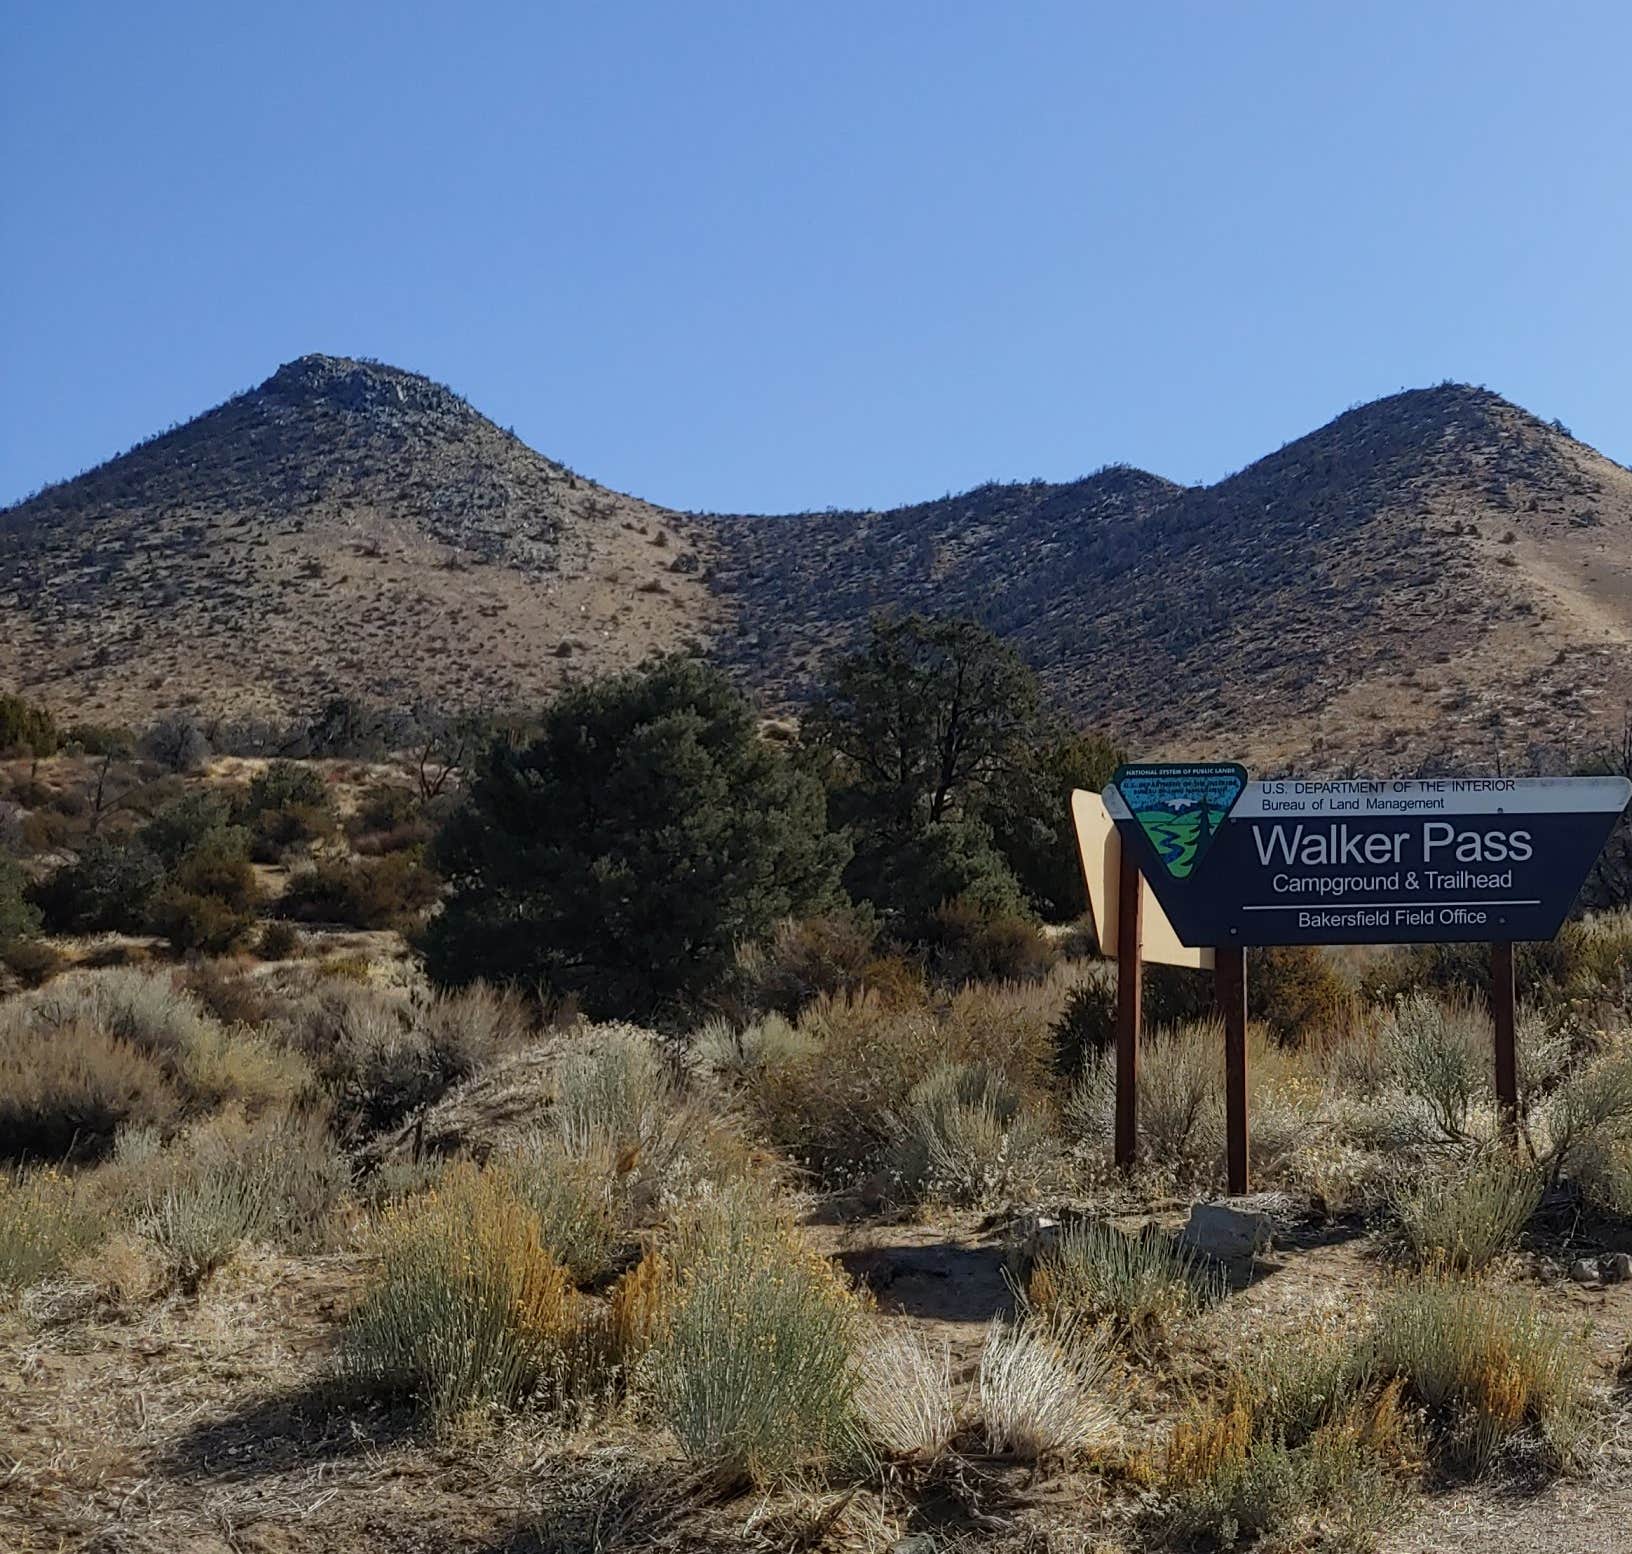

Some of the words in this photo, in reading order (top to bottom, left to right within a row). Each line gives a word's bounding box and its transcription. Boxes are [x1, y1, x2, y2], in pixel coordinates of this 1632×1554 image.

[1262, 783, 1288, 794] U.S.
[1295, 782, 1385, 794] DEPARTMENT
[1393, 782, 1409, 793] OF
[1420, 781, 1445, 793] THE
[1452, 780, 1516, 792] INTERIOR
[1262, 800, 1305, 811] Bureau
[1312, 799, 1324, 810] of
[1329, 799, 1359, 810] Land
[1366, 798, 1444, 812] Management
[1252, 823, 1410, 866] Walker
[1423, 822, 1533, 863] Pass
[1273, 872, 1399, 896] Campground
[1405, 872, 1420, 890] &
[1424, 870, 1512, 890] Trailhead
[1299, 911, 1389, 928] Bakersfield
[1395, 910, 1434, 926] Field
[1440, 909, 1487, 925] Office
